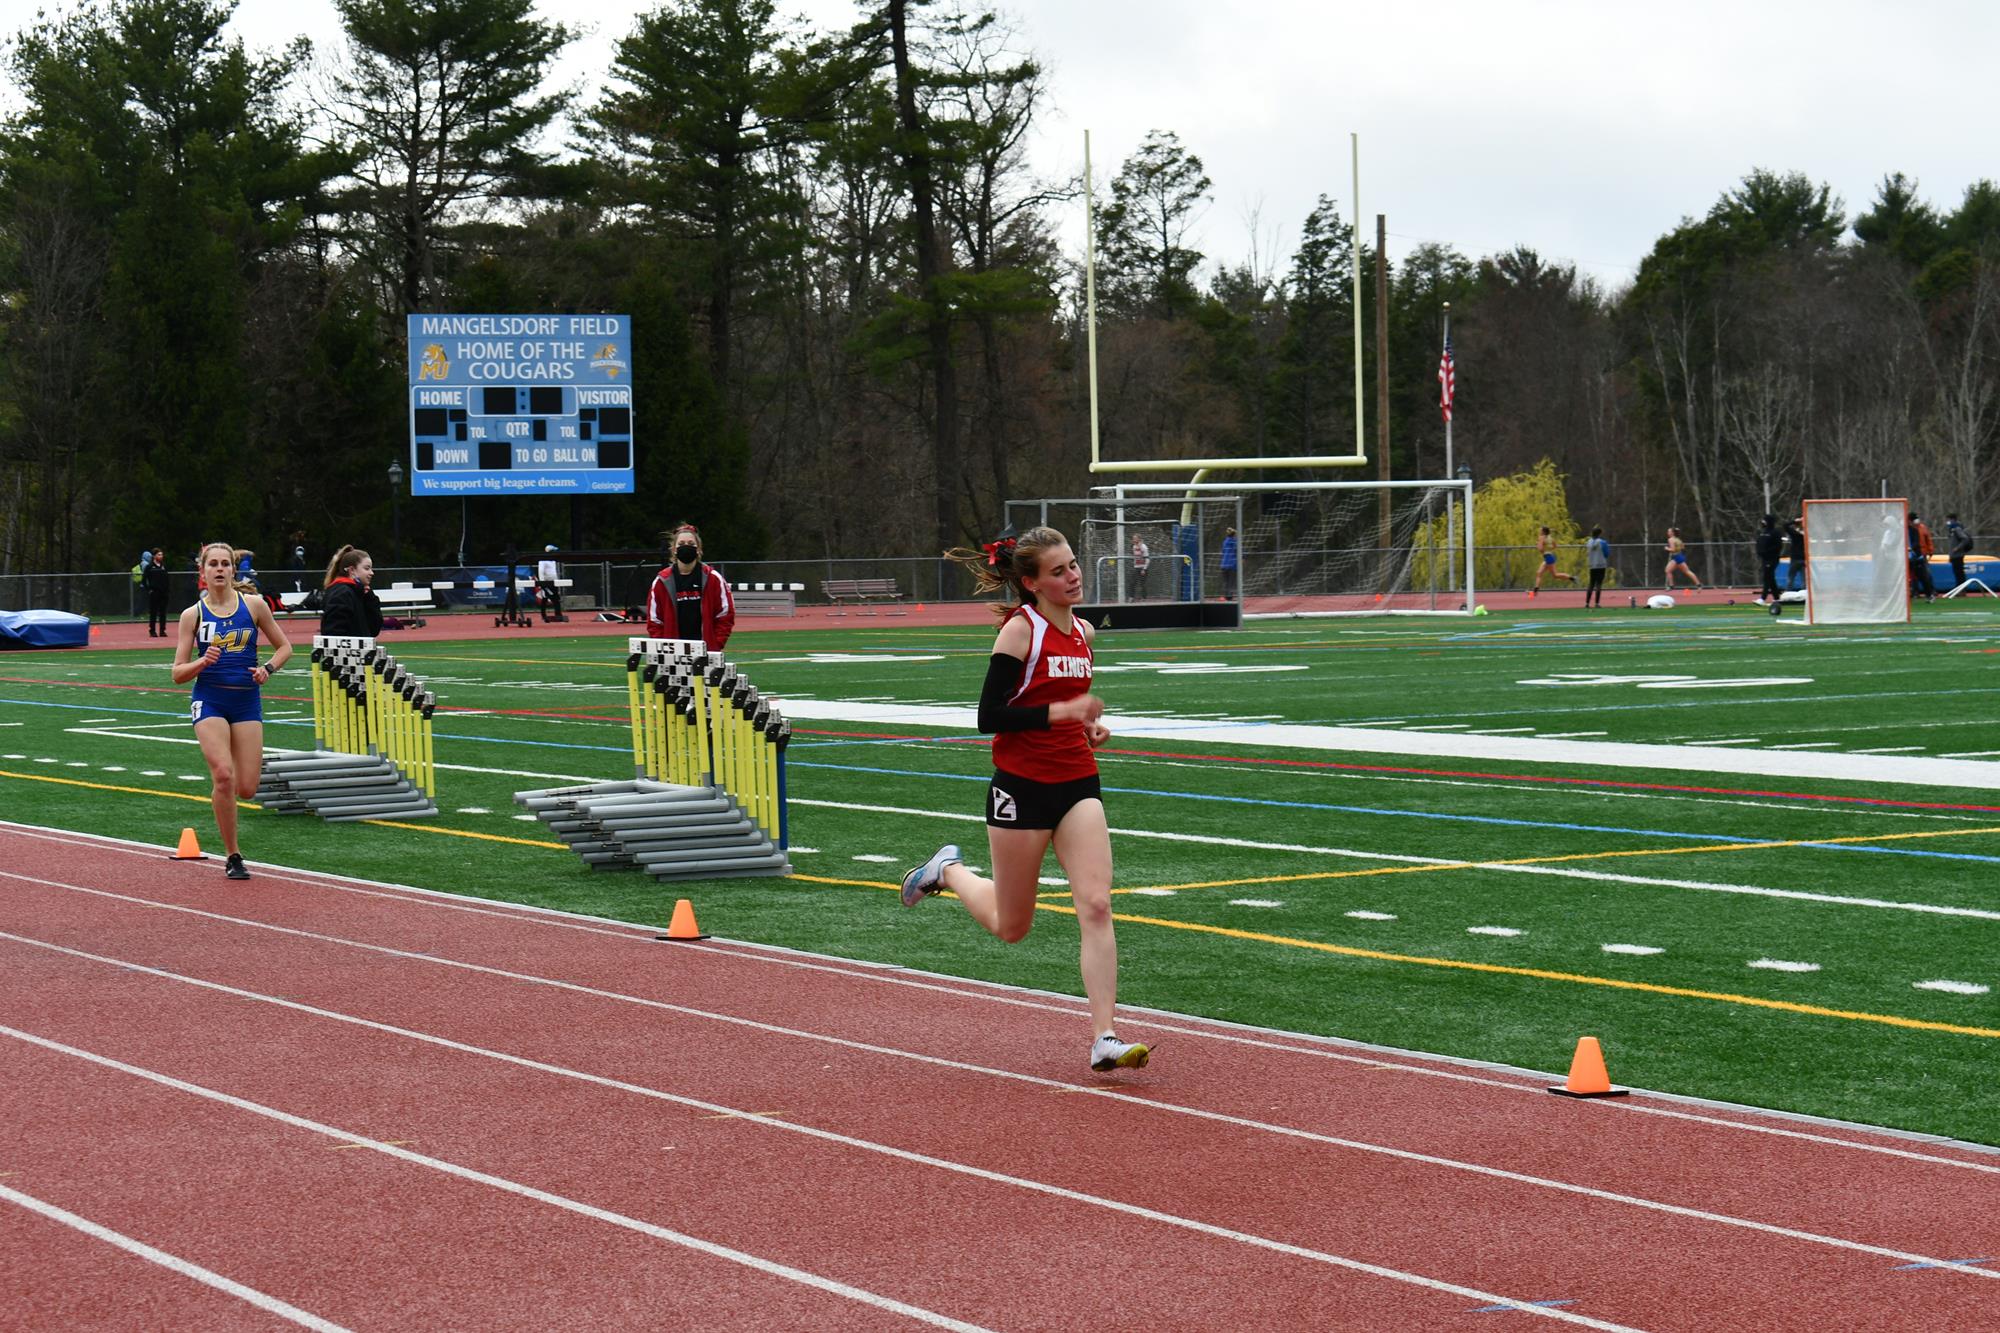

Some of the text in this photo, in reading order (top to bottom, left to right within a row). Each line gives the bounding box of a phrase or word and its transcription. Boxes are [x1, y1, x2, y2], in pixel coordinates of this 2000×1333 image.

[422, 317, 619, 335] MANGELSDORF FIELD
[457, 342, 585, 360] HOME OF THE
[418, 361, 450, 380] MU
[468, 362, 575, 380] COUGARS
[420, 391, 462, 405] HOME
[579, 390, 629, 405] VISITOR
[470, 426, 487, 438] TOL
[506, 422, 530, 437] QTR
[560, 425, 577, 438] TOL
[436, 449, 468, 464] DOWN
[516, 448, 547, 463] TO GO
[554, 447, 596, 463] BALL ON
[422, 476, 578, 491] We support big league dreams.
[202, 623, 211, 641] 1
[211, 628, 254, 653] MU
[656, 642, 675, 654] UCS
[1047, 656, 1092, 678] KING'S
[995, 790, 1012, 819] 2
